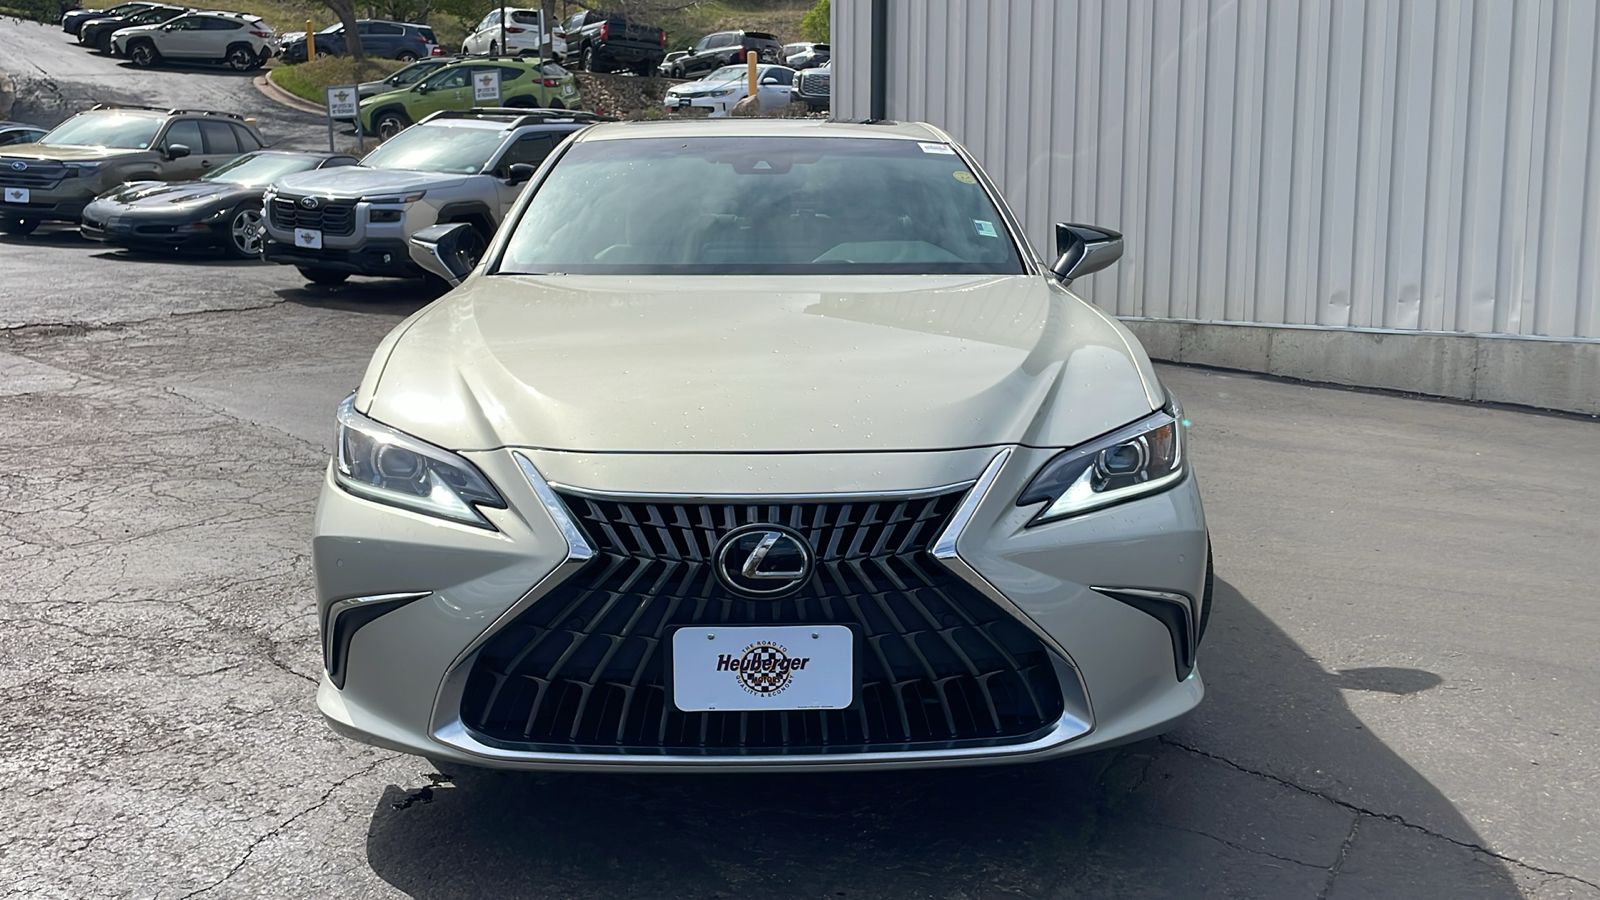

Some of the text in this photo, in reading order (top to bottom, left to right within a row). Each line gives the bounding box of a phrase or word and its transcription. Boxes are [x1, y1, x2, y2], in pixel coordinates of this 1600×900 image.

[742, 643, 754, 654] THE
[779, 644, 788, 653] TO
[716, 653, 810, 675] Heuberger
[735, 674, 758, 697] QUALITY
[767, 675, 794, 698] ECONOMY
[751, 676, 781, 684] MOTORS
